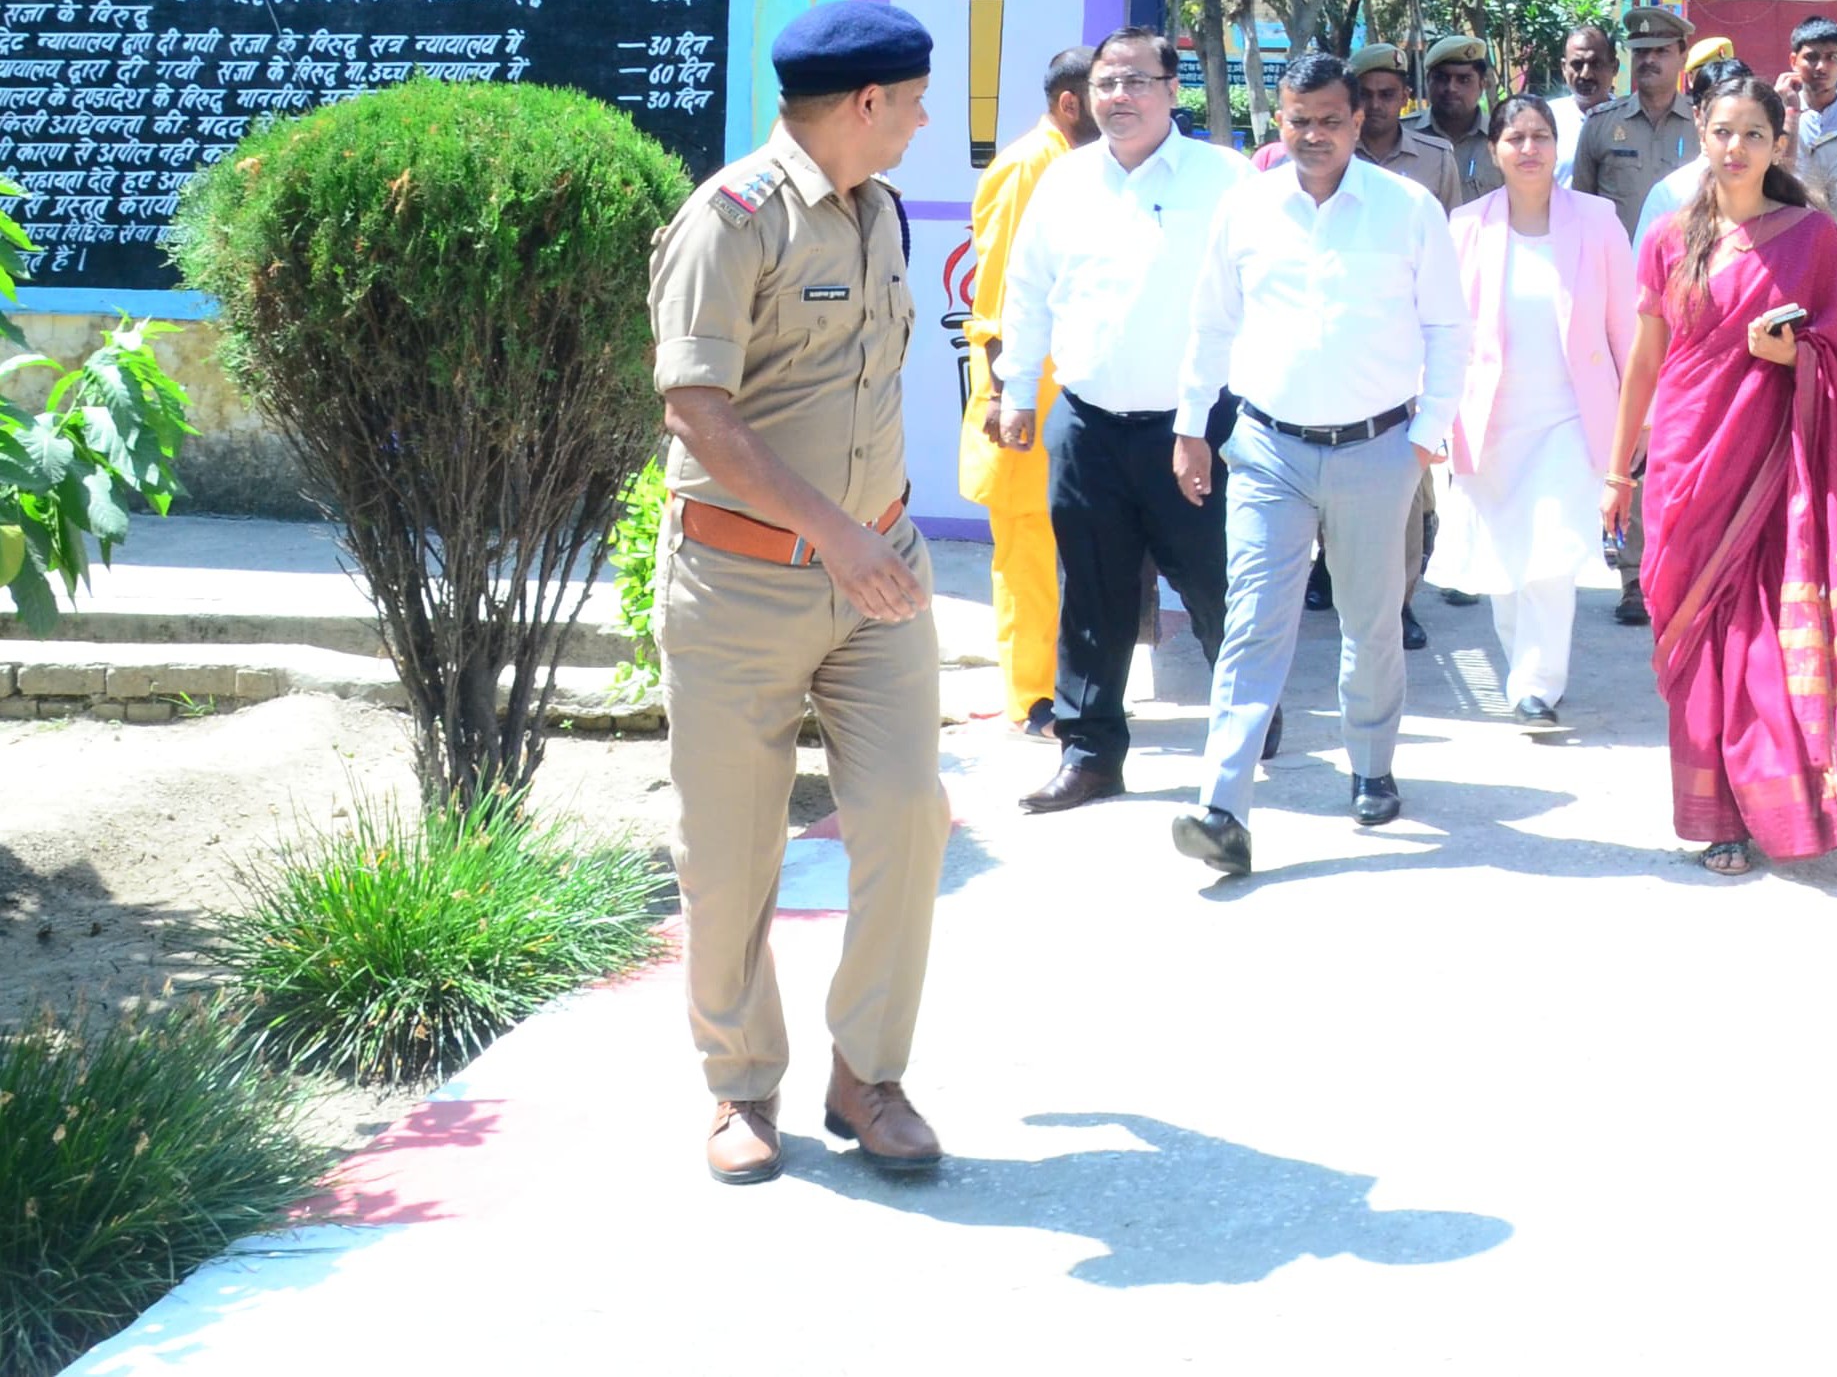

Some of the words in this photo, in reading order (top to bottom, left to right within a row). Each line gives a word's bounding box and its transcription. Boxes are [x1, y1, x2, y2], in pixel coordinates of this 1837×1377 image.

[4, 4, 55, 27] सजा
[57, 0, 82, 22] के
[37, 33, 121, 53] न्यायालय
[156, 27, 181, 56] दी
[229, 34, 272, 56] सजा
[415, 35, 501, 59] न्यायालय
[675, 31, 714, 61] दिन
[116, 55, 150, 85] दी
[217, 61, 260, 84] सजा
[267, 55, 290, 80] के
[678, 56, 715, 87] दिन
[47, 82, 70, 106] के
[152, 83, 174, 107] के
[673, 87, 714, 115] दिन
[153, 109, 189, 134] की
[74, 137, 97, 166] से
[97, 138, 157, 165] अपील
